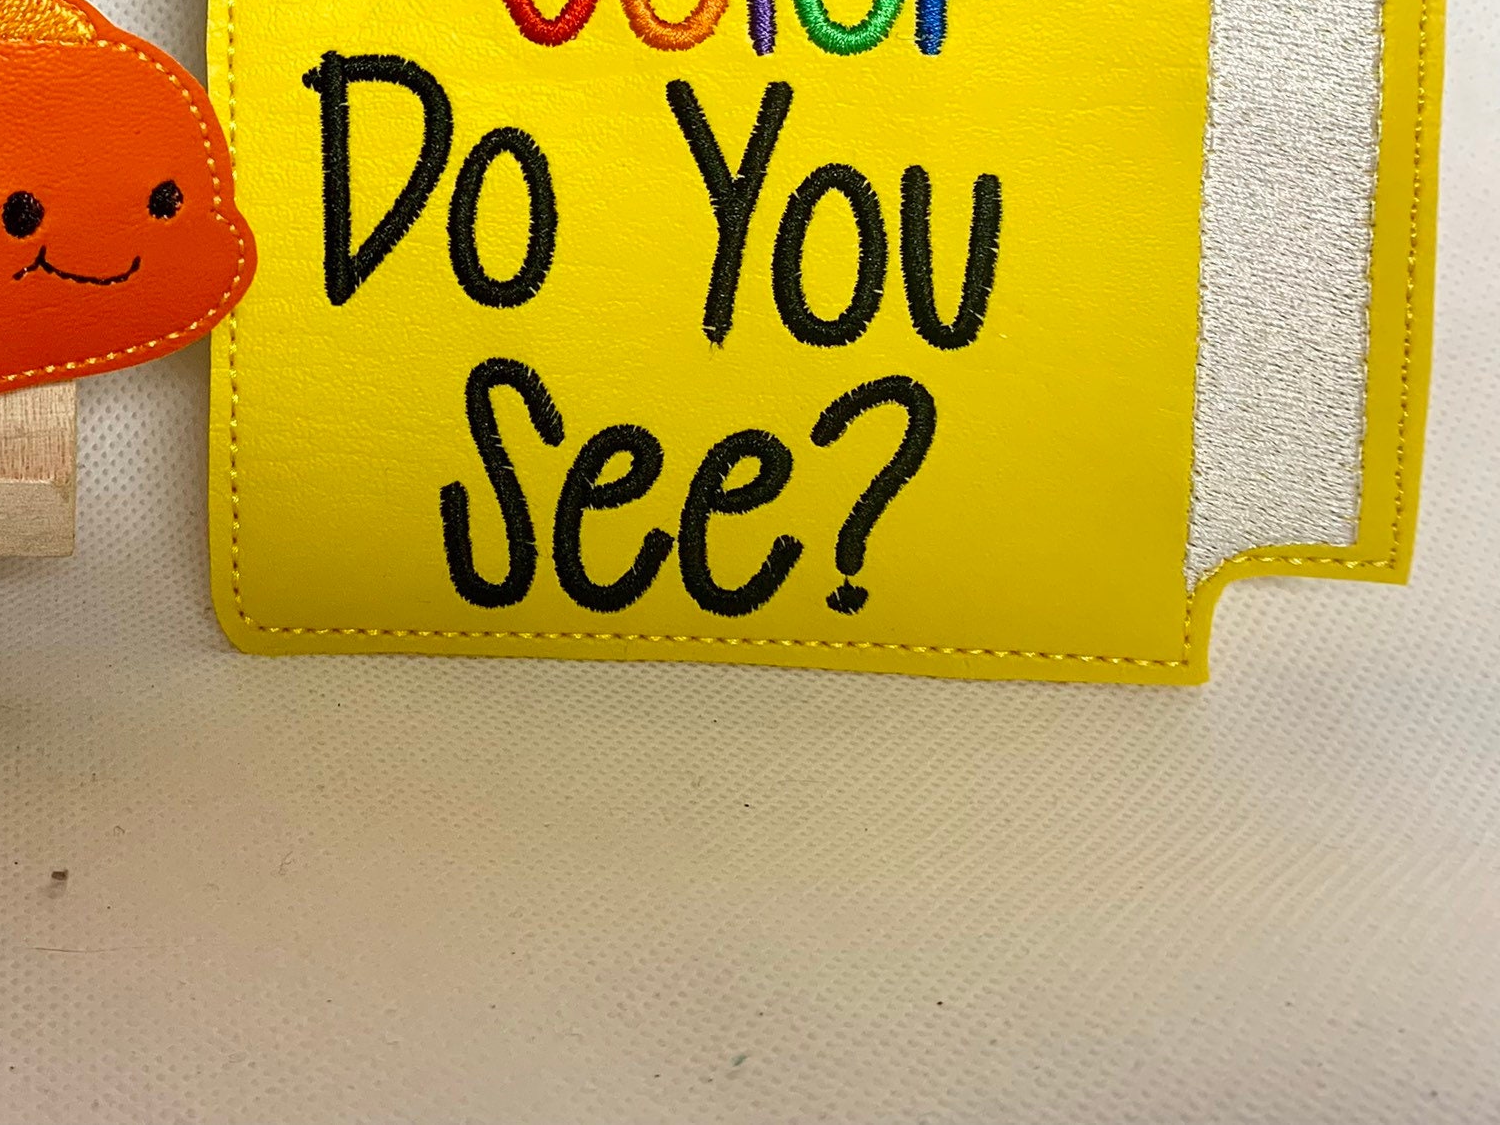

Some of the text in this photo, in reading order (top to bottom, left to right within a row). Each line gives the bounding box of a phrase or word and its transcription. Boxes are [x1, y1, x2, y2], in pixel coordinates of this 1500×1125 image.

[302, 50, 1002, 350] Do You
[440, 357, 937, 617] See?
